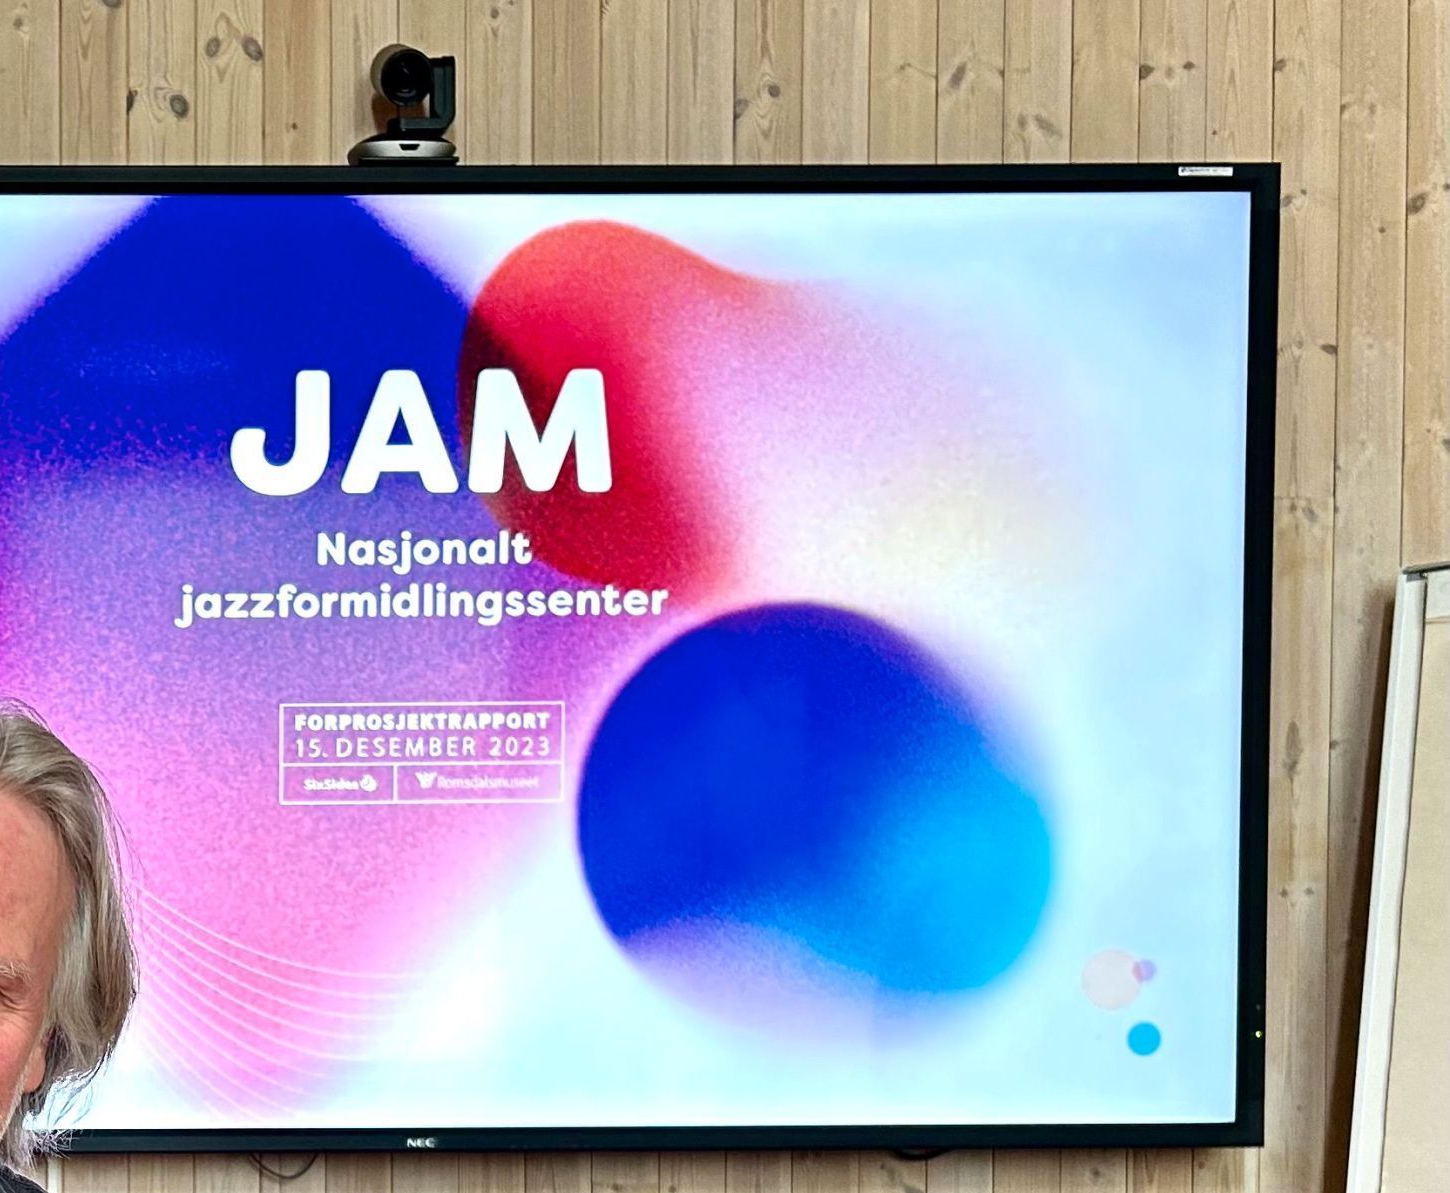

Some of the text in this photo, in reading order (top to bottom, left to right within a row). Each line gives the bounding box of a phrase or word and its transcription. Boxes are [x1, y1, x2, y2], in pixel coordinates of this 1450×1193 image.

[230, 368, 612, 496] JAM
[316, 530, 532, 575] Nasjonalt
[174, 584, 668, 628] jazzformidlingssenter
[294, 711, 551, 732] FORPROSJEKTRAPPORT
[295, 736, 551, 758] 15. DESEMBER 2023
[406, 1137, 436, 1149] NEC
